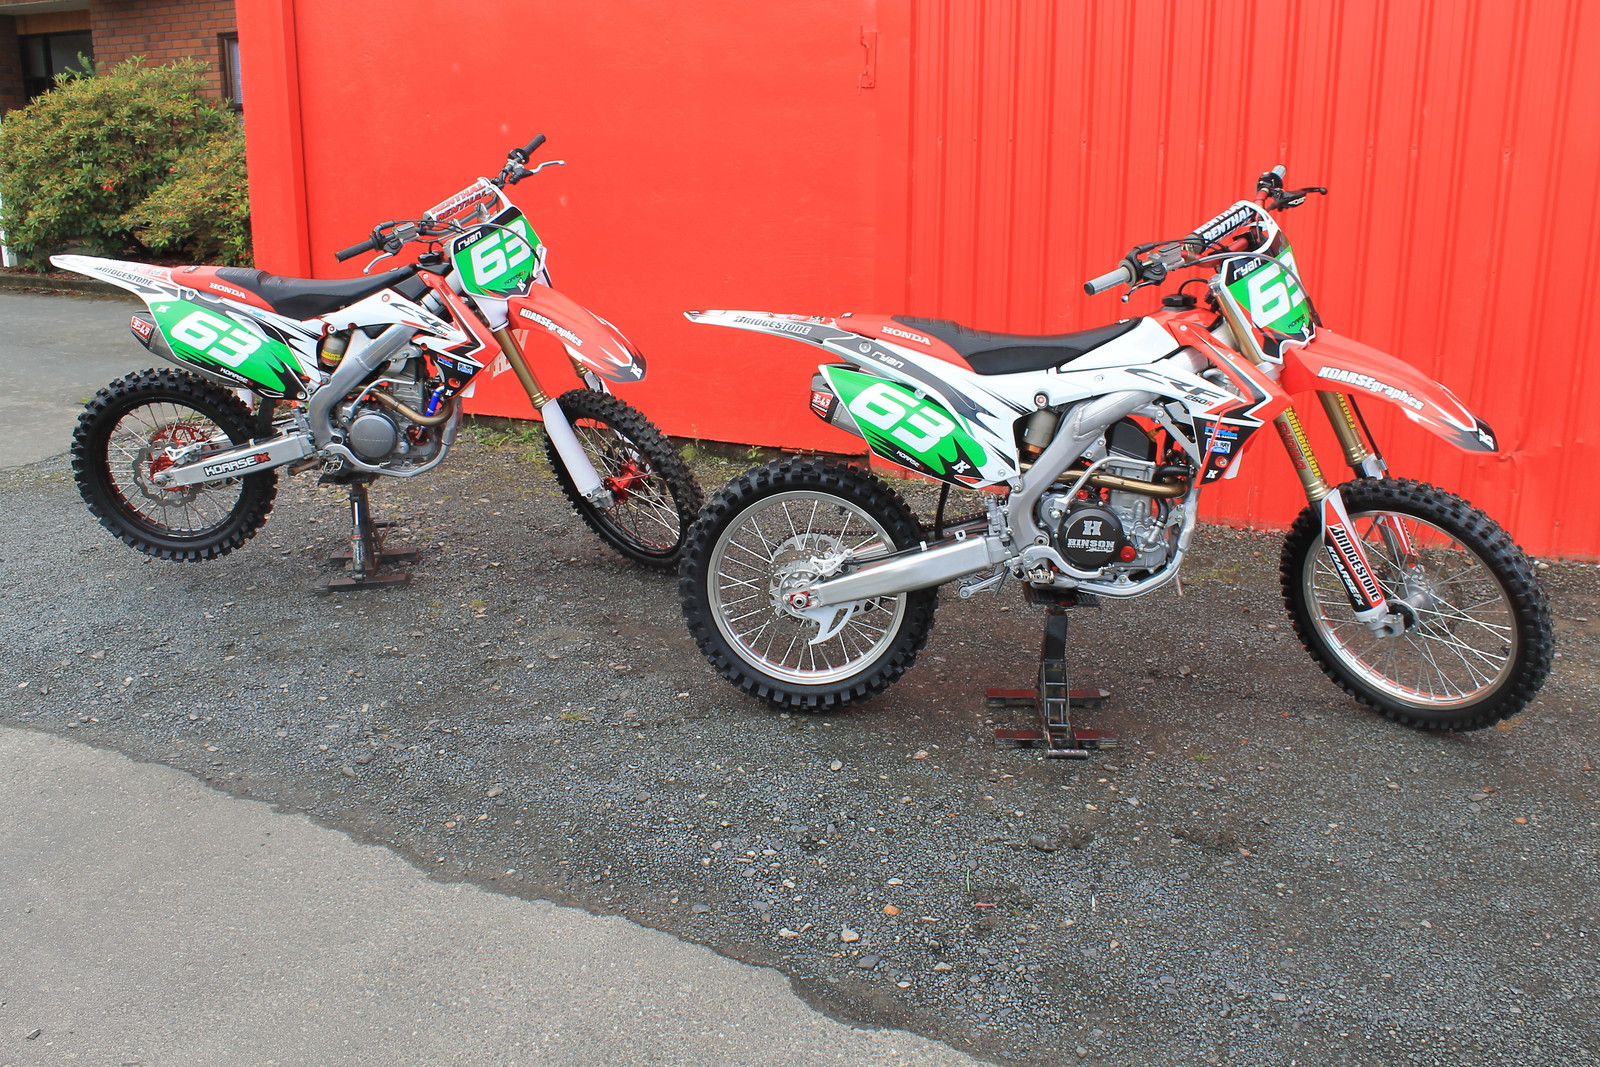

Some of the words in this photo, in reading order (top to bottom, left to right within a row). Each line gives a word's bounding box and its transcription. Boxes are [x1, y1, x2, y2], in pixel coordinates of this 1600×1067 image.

[1193, 203, 1246, 235] RENTHA
[1202, 207, 1254, 244] RENTHAL
[458, 231, 482, 251] ryan
[470, 219, 531, 286] 63
[94, 266, 154, 287] BRIDGESTONE
[1234, 257, 1261, 281] ryan
[209, 282, 246, 300] HONDA
[519, 307, 584, 347] KOARSEgraphics
[733, 316, 813, 336] BRIDGESTONE
[881, 326, 932, 346] HONDA
[170, 310, 262, 368] 63
[872, 351, 905, 369] ryan
[1317, 366, 1425, 411] KOARSEgraphics
[1184, 394, 1215, 407] 250R
[849, 382, 956, 453] 63
[1082, 520, 1102, 536] H
[1067, 538, 1115, 548] HINSON
[1326, 523, 1381, 603] BRIDGESTONE
